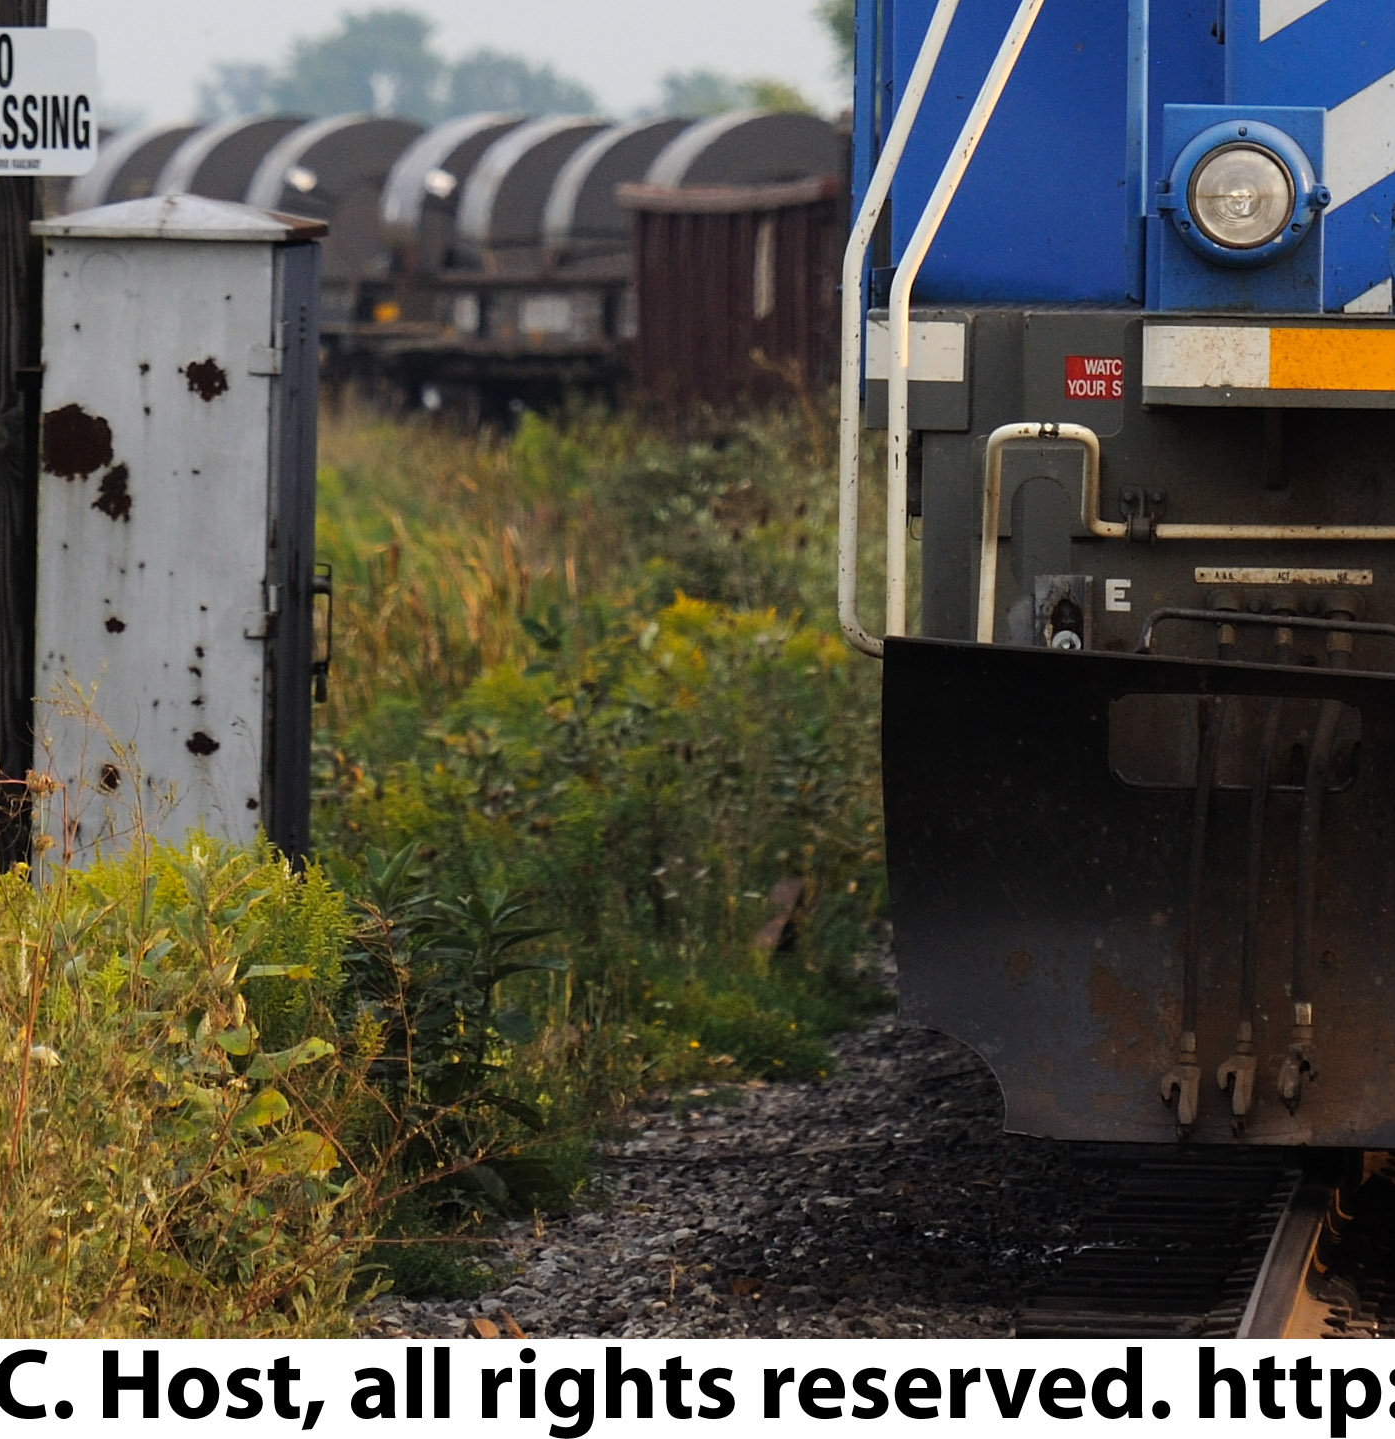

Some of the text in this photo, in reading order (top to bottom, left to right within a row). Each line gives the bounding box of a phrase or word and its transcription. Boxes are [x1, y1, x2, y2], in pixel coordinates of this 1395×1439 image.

[1084, 359, 1122, 376] WATC
[1067, 379, 1106, 396] YOUR
[1105, 578, 1131, 612] E
